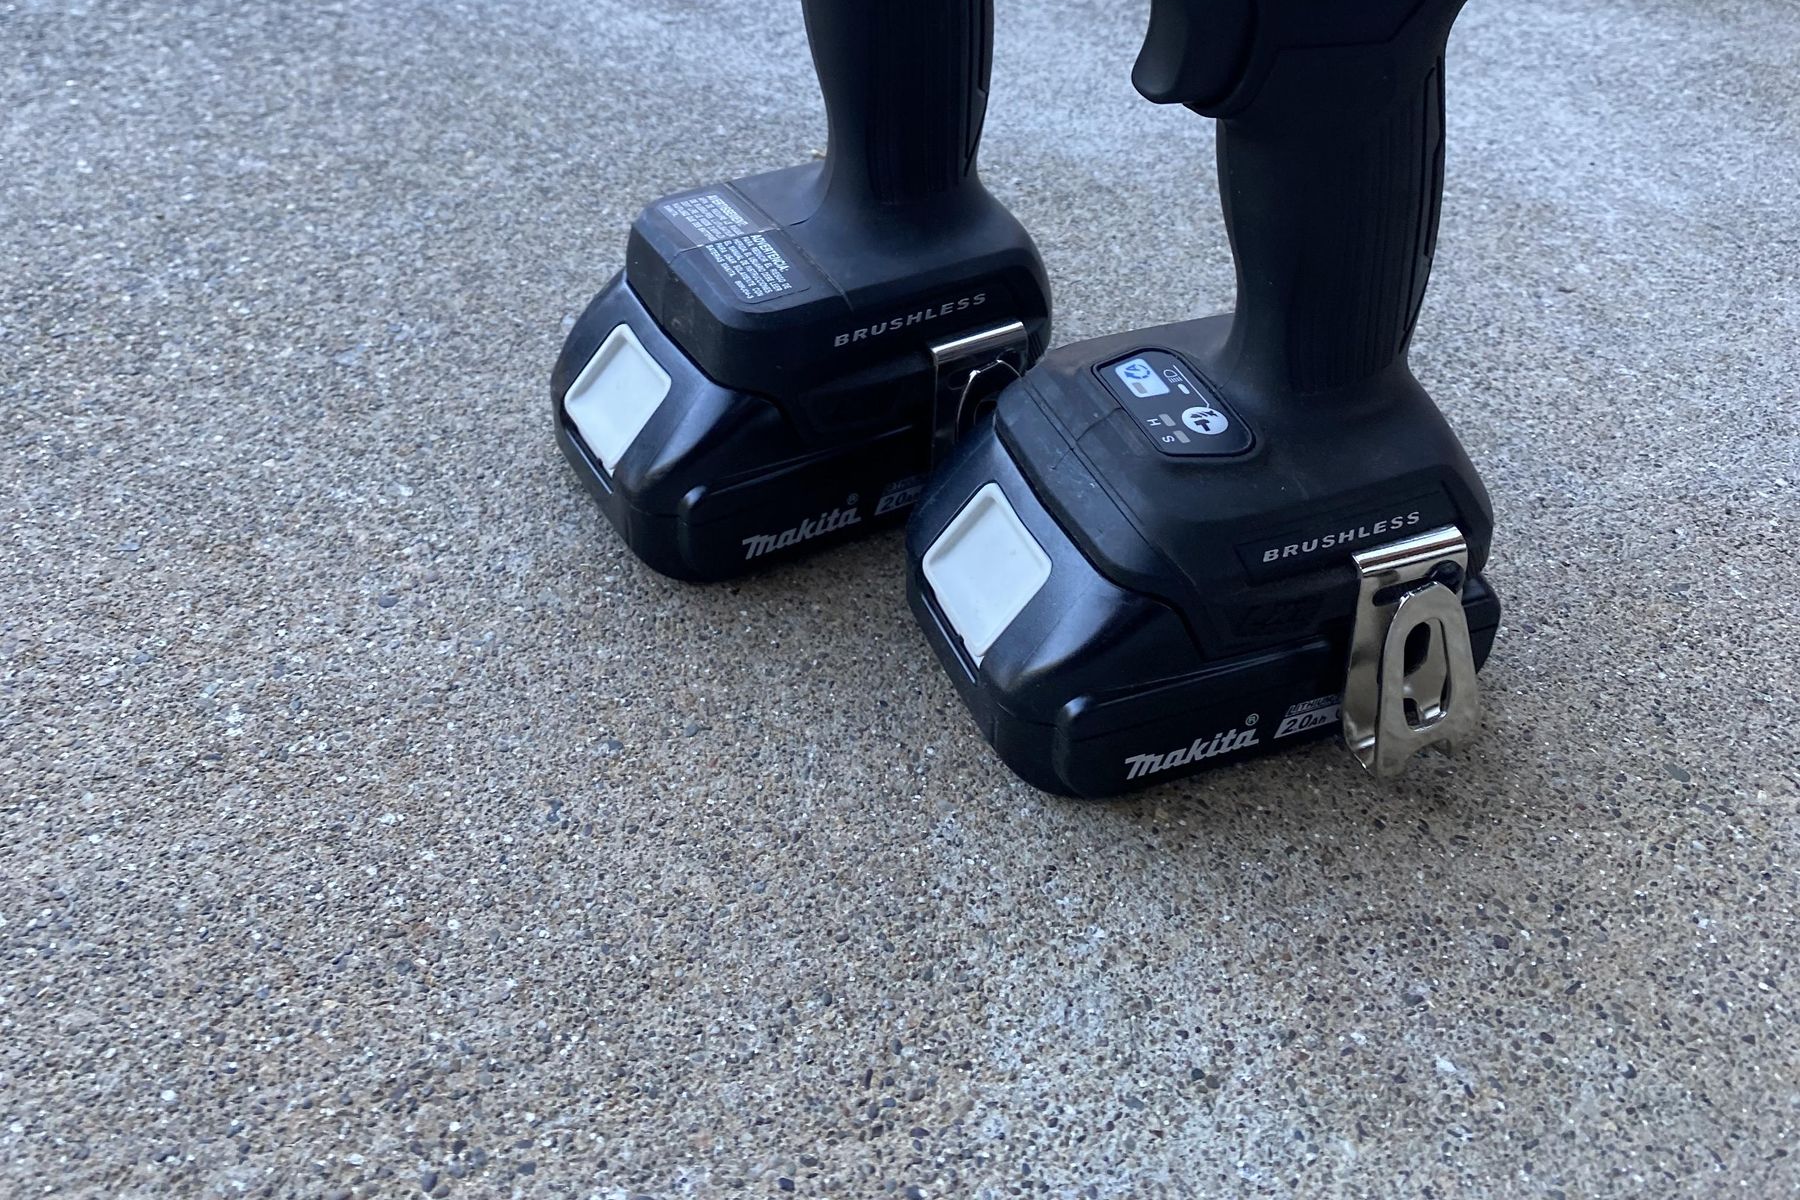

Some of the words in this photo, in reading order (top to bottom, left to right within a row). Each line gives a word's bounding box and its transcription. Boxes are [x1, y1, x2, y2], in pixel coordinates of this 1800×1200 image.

[833, 293, 987, 347] BRUSHLESS
[1146, 417, 1161, 427] H
[1161, 435, 1175, 443] S
[1262, 511, 1421, 563] BRUSHLESS
